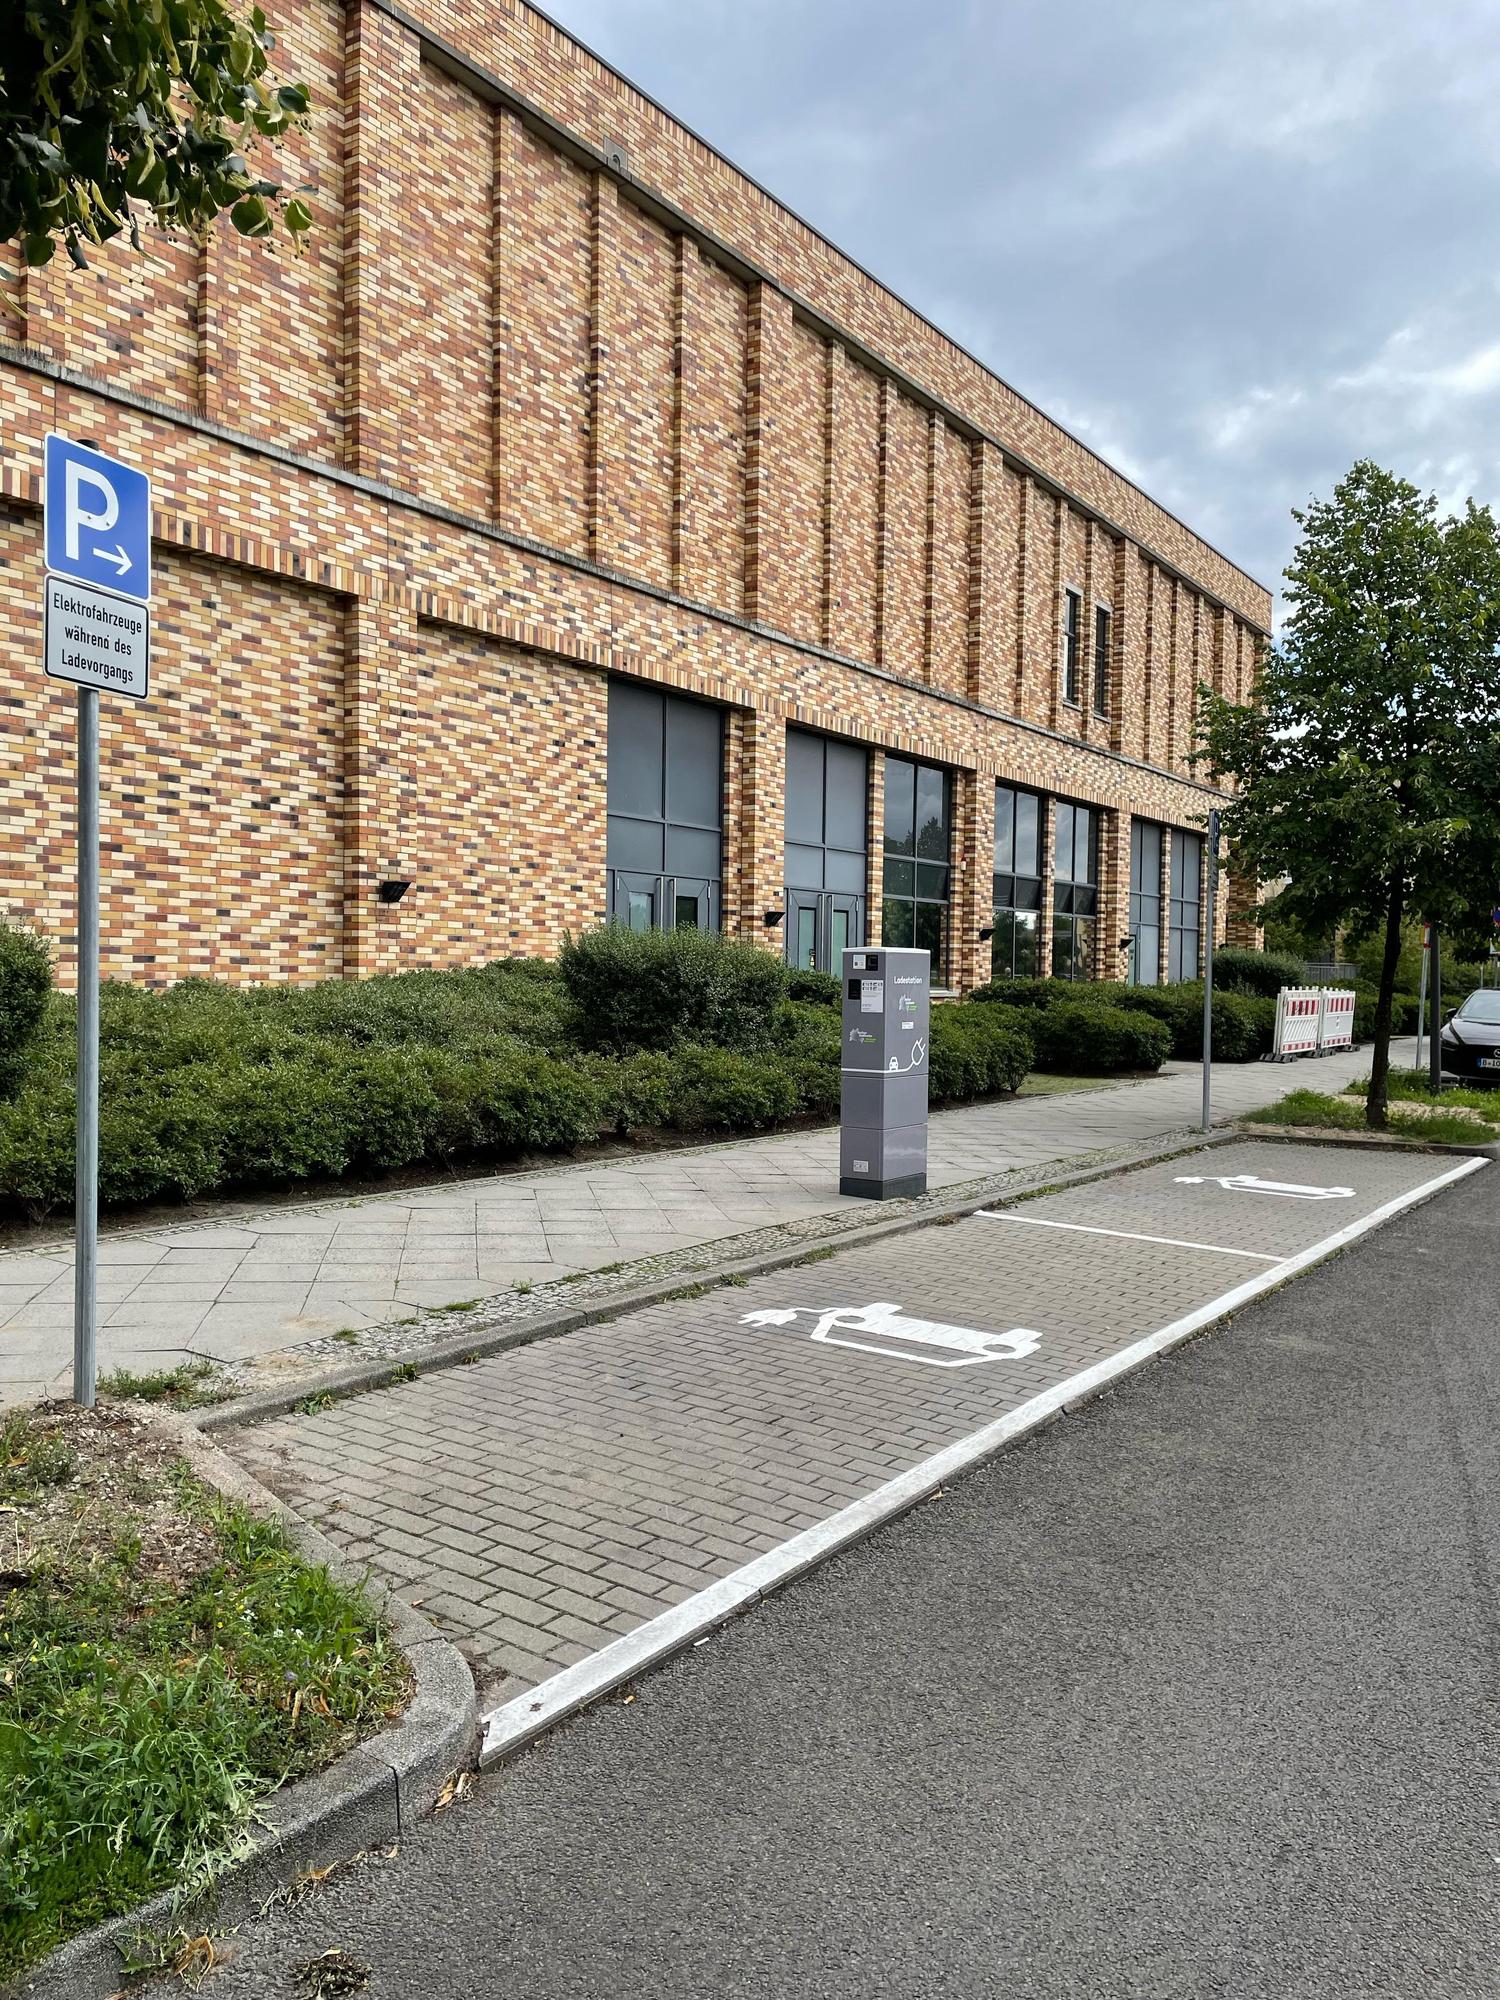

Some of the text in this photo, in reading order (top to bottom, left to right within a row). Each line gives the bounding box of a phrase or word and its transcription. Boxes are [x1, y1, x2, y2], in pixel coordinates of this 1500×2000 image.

[65, 459, 119, 561] P
[54, 592, 142, 635] Elektrofahrzeuge
[65, 625, 132, 655] während des
[61, 648, 133, 684] Ladevorgangs
[893, 975, 923, 984] Ladestation
